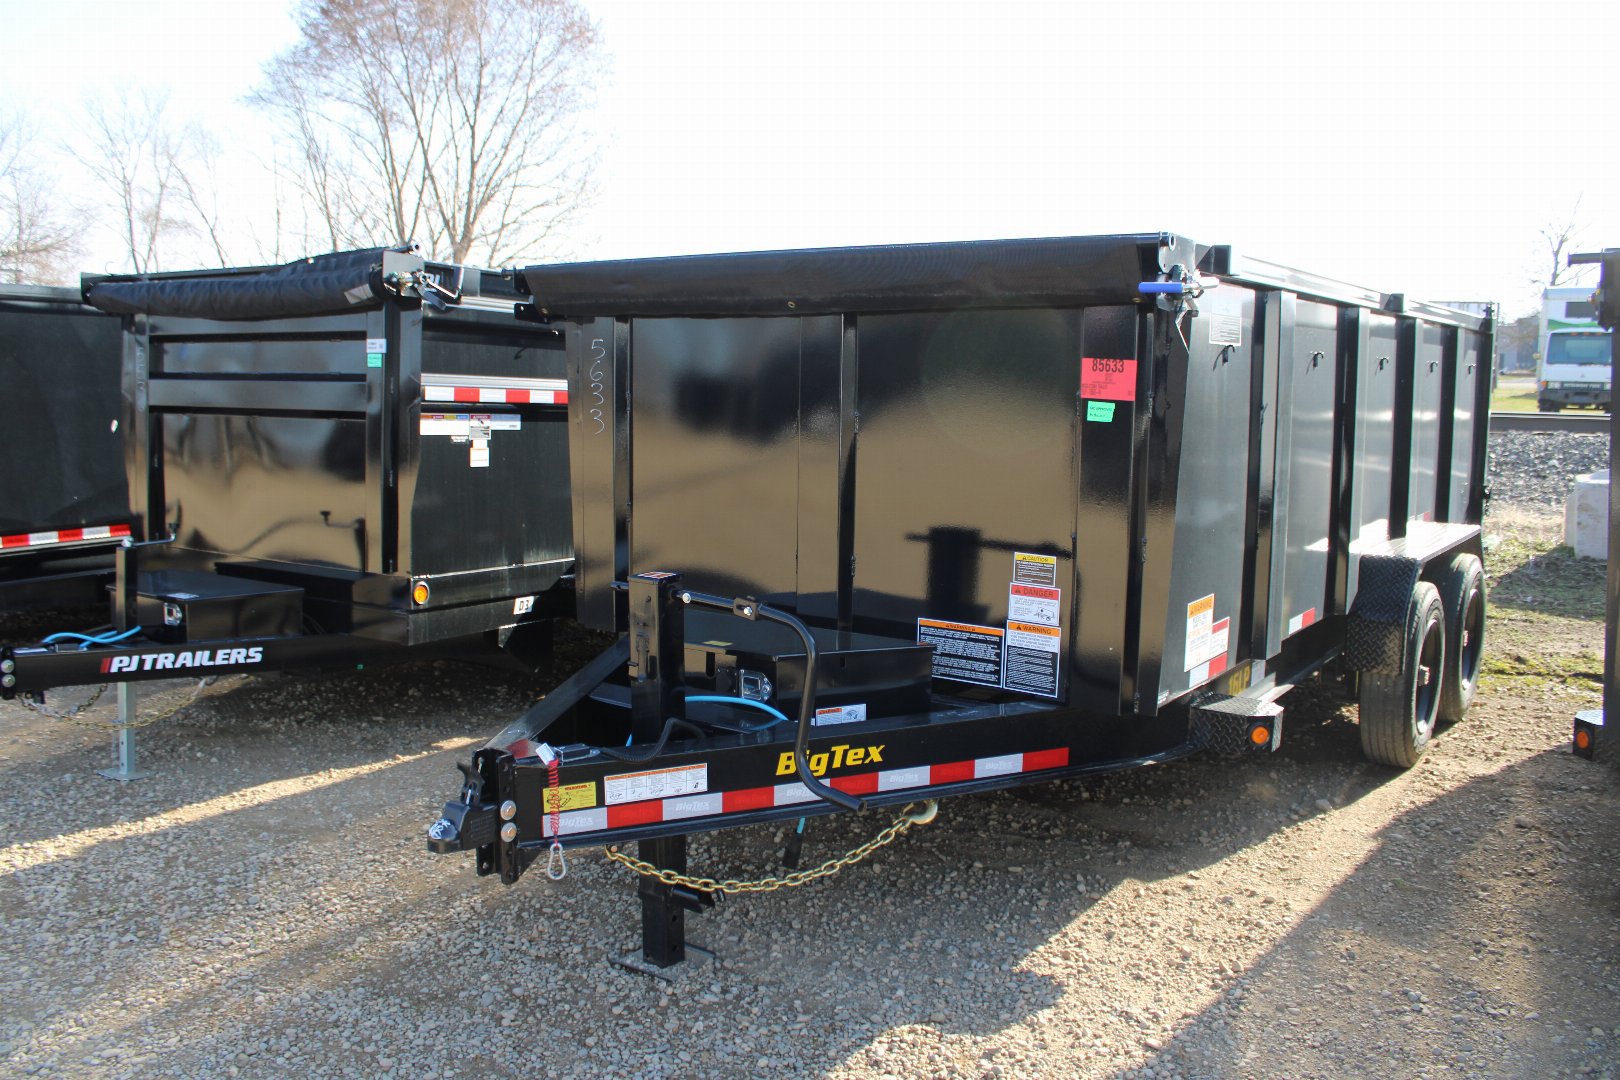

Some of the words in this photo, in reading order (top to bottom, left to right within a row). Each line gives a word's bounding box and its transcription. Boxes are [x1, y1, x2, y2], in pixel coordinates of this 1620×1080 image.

[1091, 358, 1125, 373] 85633
[589, 338, 607, 435] 5633
[1023, 587, 1054, 598] DANGER
[1022, 625, 1052, 635] WARNING
[109, 655, 140, 673] PJ
[141, 647, 263, 671] TRAILERS
[775, 744, 886, 777] BgTex
[676, 801, 710, 813] BigTex
